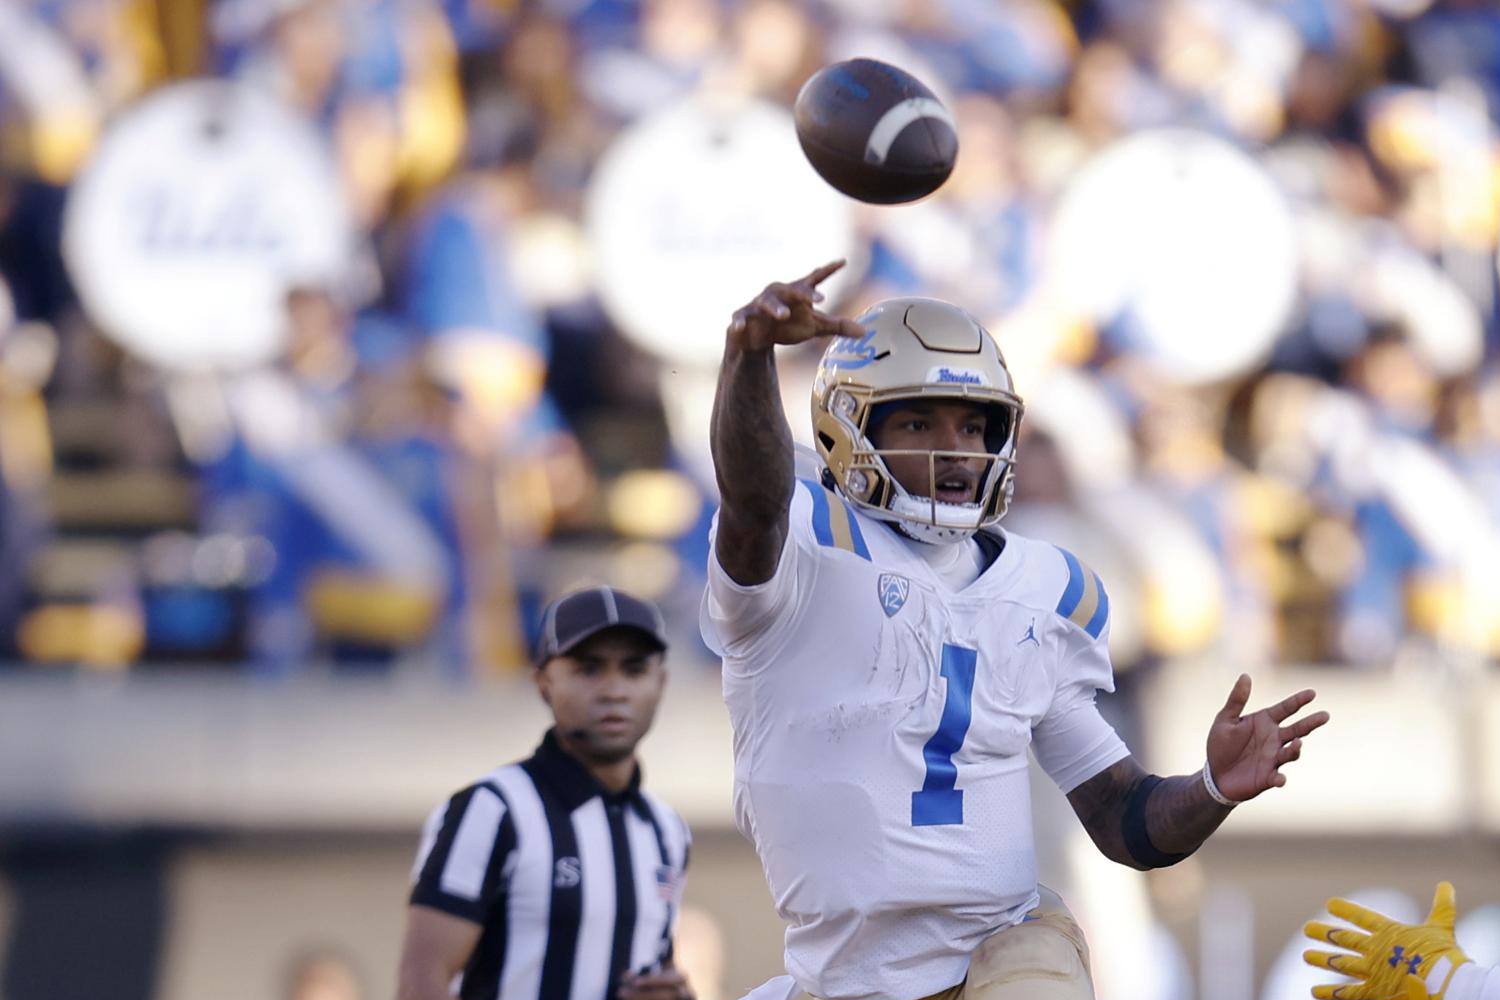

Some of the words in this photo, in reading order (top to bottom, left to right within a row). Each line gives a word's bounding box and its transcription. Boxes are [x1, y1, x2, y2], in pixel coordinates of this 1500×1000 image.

[881, 575, 908, 602] PAC
[885, 591, 901, 609] 12
[912, 643, 977, 826] 1
[554, 856, 580, 888] S
